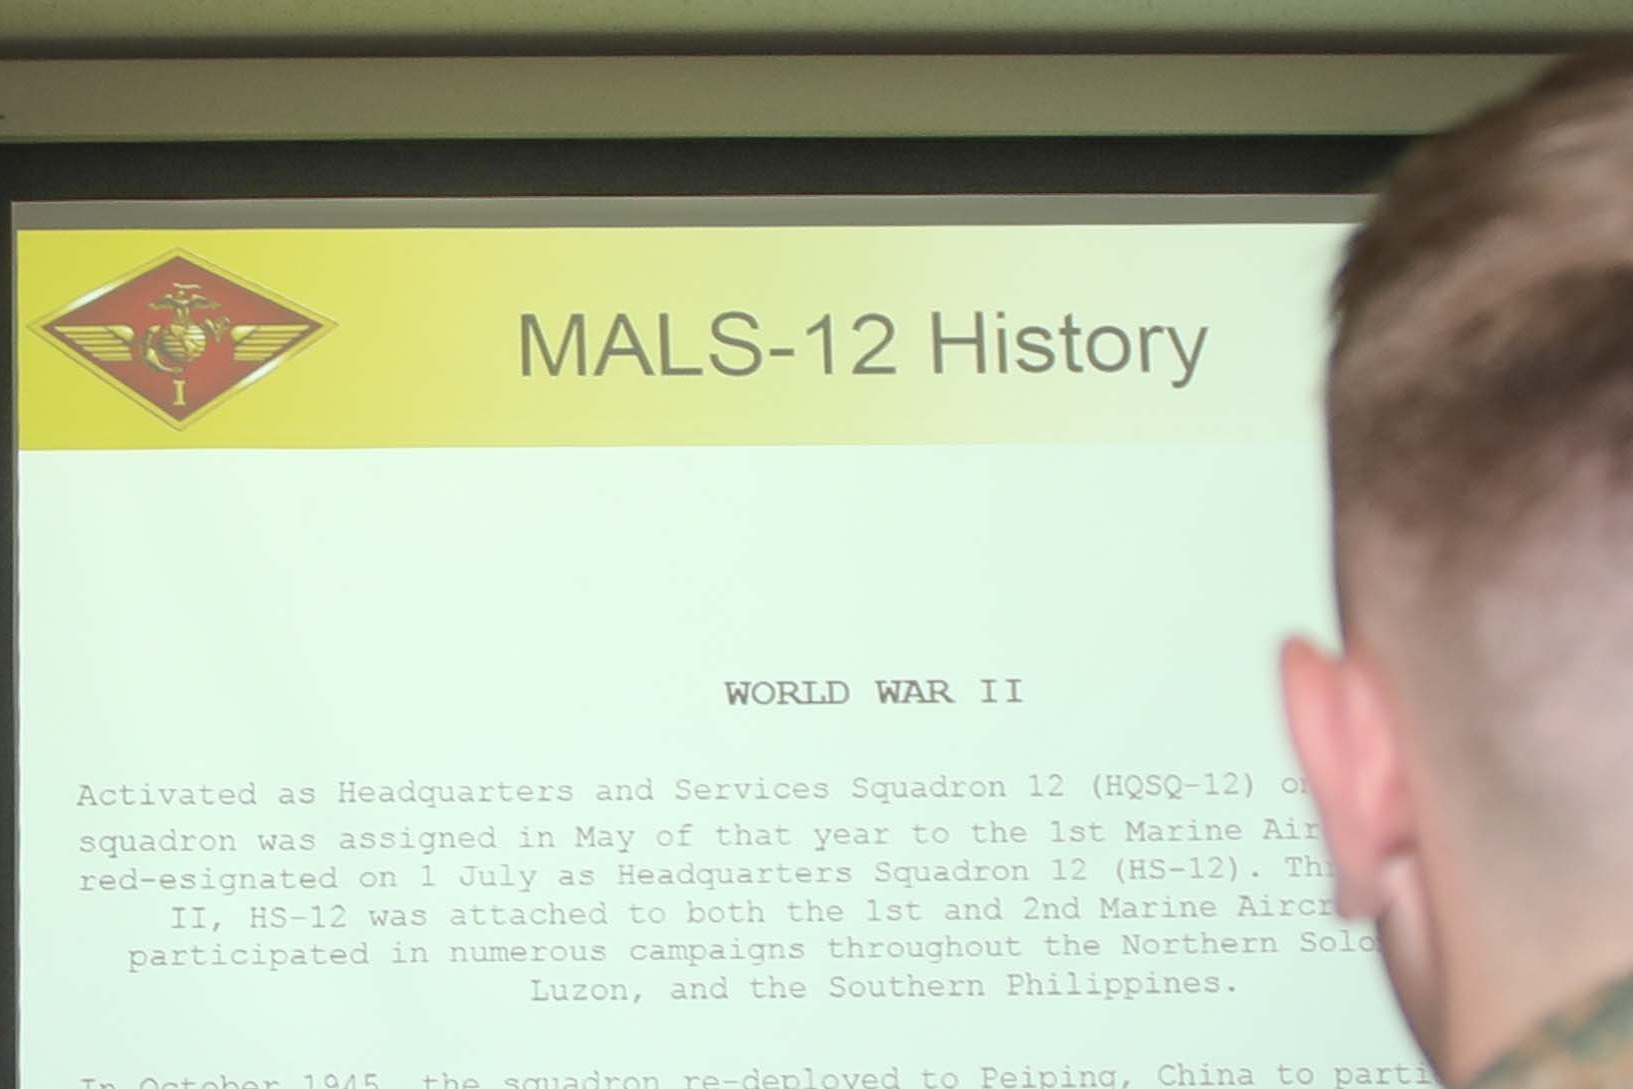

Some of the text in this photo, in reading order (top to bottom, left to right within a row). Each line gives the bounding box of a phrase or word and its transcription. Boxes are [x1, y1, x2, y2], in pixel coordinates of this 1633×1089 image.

[520, 310, 1209, 390] MALS-12 History
[724, 678, 1024, 706] WORLD WAR II
[76, 781, 257, 807] Activated
[278, 787, 315, 805] as
[338, 779, 573, 808] Headquarters
[596, 778, 654, 801] and
[675, 777, 830, 800] Services
[852, 774, 1006, 804] Squadron
[1029, 773, 1064, 797] 12
[1093, 772, 1253, 800] (HQSQ-12)
[79, 828, 237, 859] squadron
[257, 833, 315, 851] was
[339, 825, 497, 855] assigned
[518, 826, 555, 848] in
[574, 826, 636, 854] May
[656, 823, 693, 847] of
[715, 823, 791, 846] that
[814, 827, 890, 852] year
[911, 824, 950, 844] to
[971, 820, 1027, 844] the
[1051, 820, 1106, 843] 1st
[1126, 819, 1242, 842] Marine
[79, 866, 338, 896] red-esignated
[359, 871, 397, 888] on
[422, 864, 436, 886] 1
[459, 864, 537, 893] July
[558, 870, 595, 886] as
[617, 862, 852, 891] Headquarters
[875, 858, 1030, 888] Squadron
[1051, 857, 1086, 881] 12
[1116, 856, 1259, 885] (HS-12).
[171, 906, 221, 933] II,
[250, 904, 346, 928] HS-12
[368, 909, 427, 927] was
[450, 901, 608, 926] attached
[628, 904, 666, 924] to
[686, 899, 766, 924] both
[787, 899, 844, 922] the
[867, 899, 922, 922] 1st
[945, 896, 1003, 920] and
[1023, 896, 1082, 920] 2nd
[1099, 896, 1217, 919] Marine
[128, 929, 1378, 973] participated in numerous campaigns throughout the Northern Solo
[531, 971, 1235, 1004] Luzon, and the Southern Philippines.
[921, 1069, 959, 1089] to
[1158, 1062, 1254, 1086] China
[1277, 1064, 1314, 1085] to
